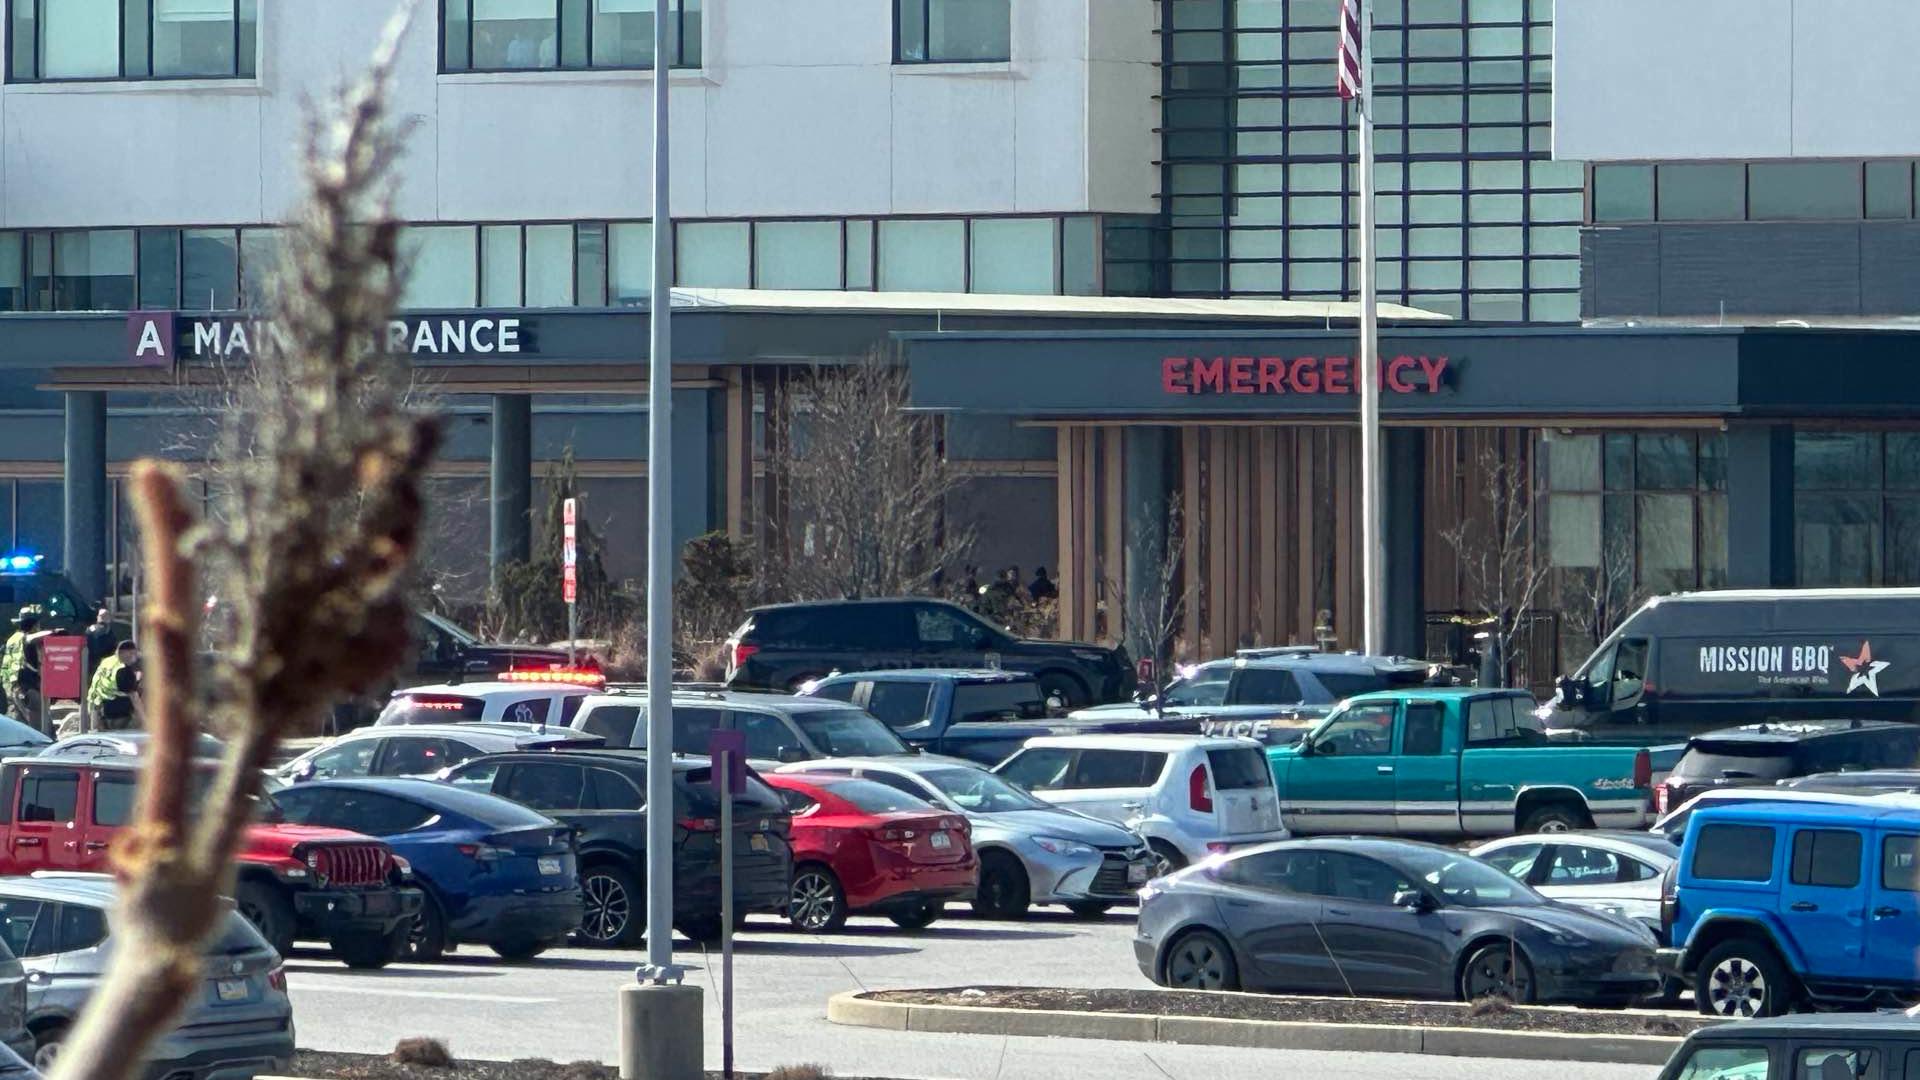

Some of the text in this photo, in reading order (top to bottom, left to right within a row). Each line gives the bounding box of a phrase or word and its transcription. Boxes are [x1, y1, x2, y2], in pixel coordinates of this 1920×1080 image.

[136, 320, 165, 356] A
[1700, 645, 1829, 674] MISSION BBQ
